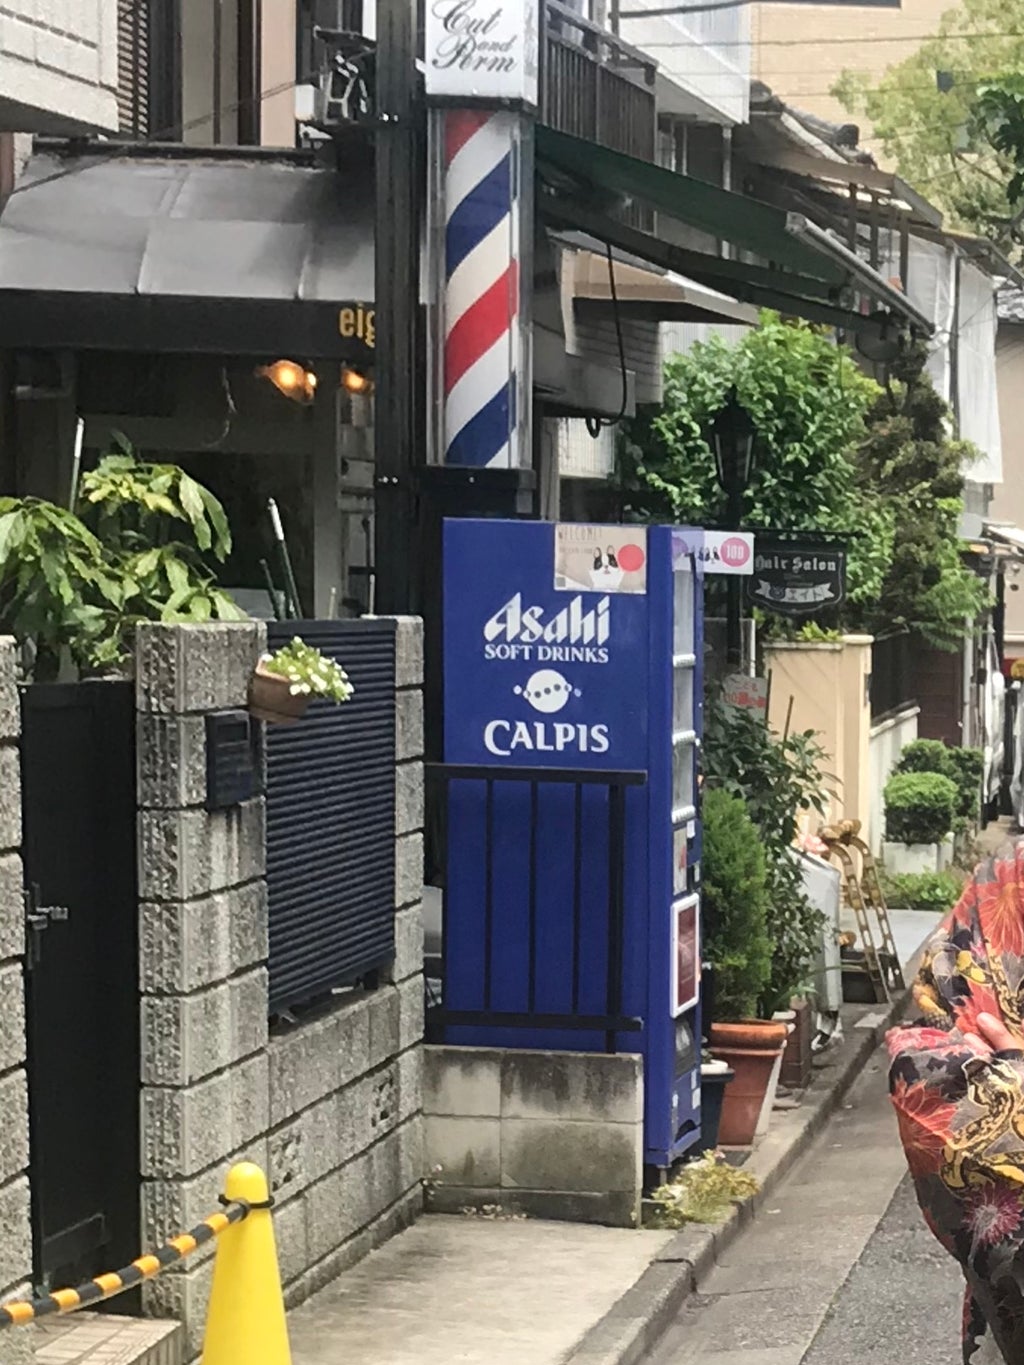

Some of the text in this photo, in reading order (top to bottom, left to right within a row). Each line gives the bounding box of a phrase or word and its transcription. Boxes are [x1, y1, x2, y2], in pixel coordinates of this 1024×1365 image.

[432, 0, 502, 34] Cut
[477, 34, 518, 52] and
[755, 554, 837, 574] Hair Salon
[484, 592, 610, 646] Asahi
[484, 643, 609, 664] SOFT DRINKS
[484, 719, 610, 757] CALPIS
